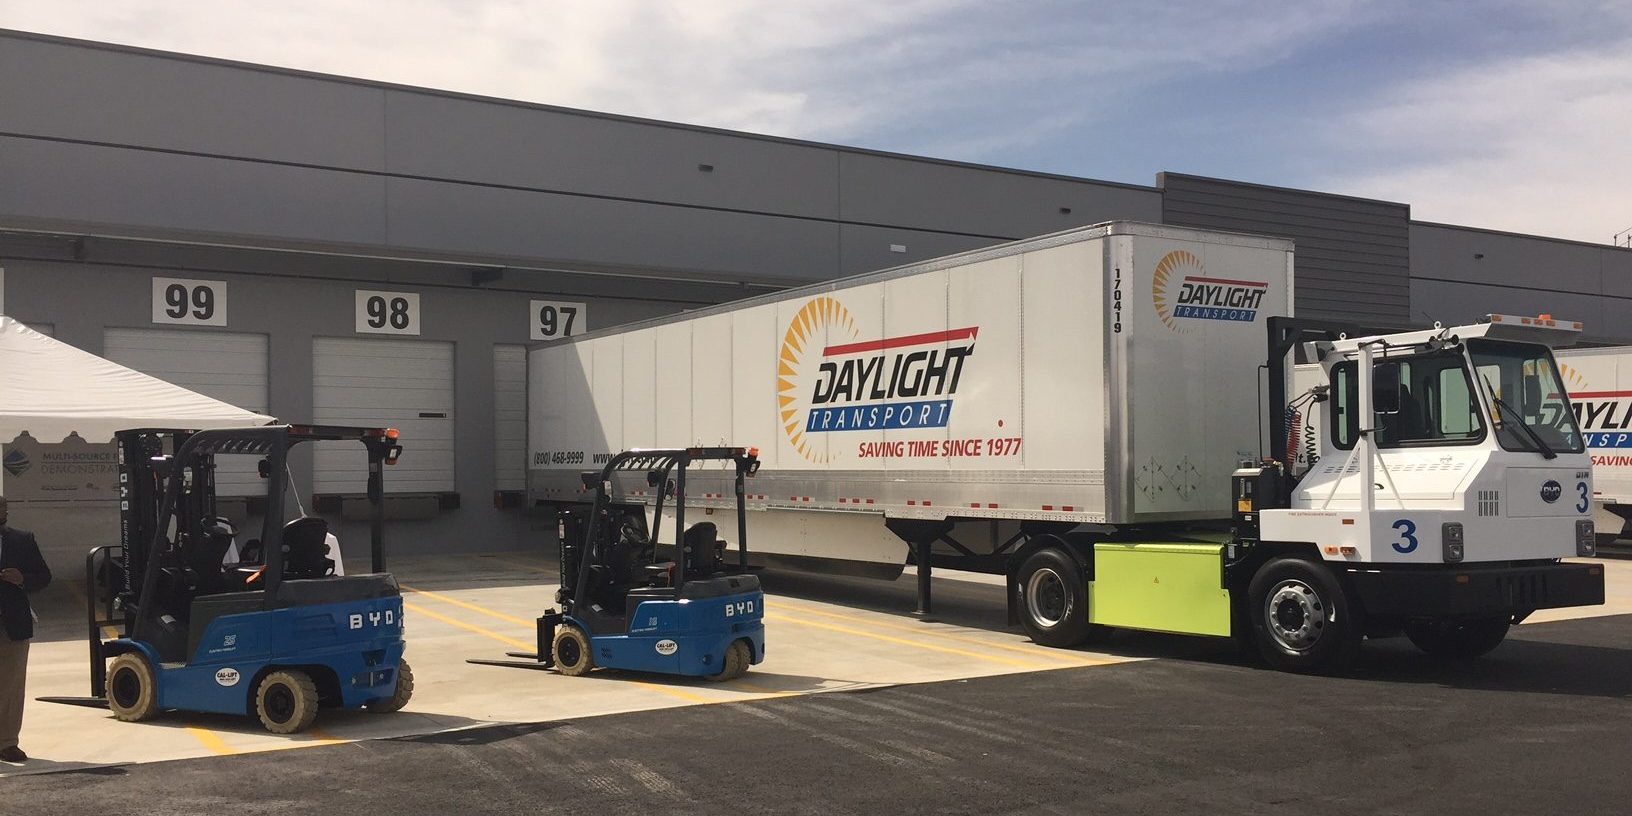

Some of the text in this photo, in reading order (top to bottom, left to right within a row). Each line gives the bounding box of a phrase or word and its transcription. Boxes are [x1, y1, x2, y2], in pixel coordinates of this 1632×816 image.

[165, 283, 215, 320] 99
[1114, 268, 1122, 333] 170419
[1177, 283, 1266, 309] DAYLIGHT
[366, 295, 409, 330] 98
[540, 305, 576, 336] 97
[1176, 305, 1254, 320] TRANSPORT
[811, 342, 975, 404] DAYLIGHT
[810, 403, 948, 429] TRANSPORT
[552, 451, 584, 464] 468-9999
[858, 437, 1022, 458] SAVING TIME SINCE 1977
[1575, 481, 1589, 513] 3
[1391, 518, 1418, 554] 3
[349, 609, 394, 629] BYD
[725, 600, 754, 617] BYD
